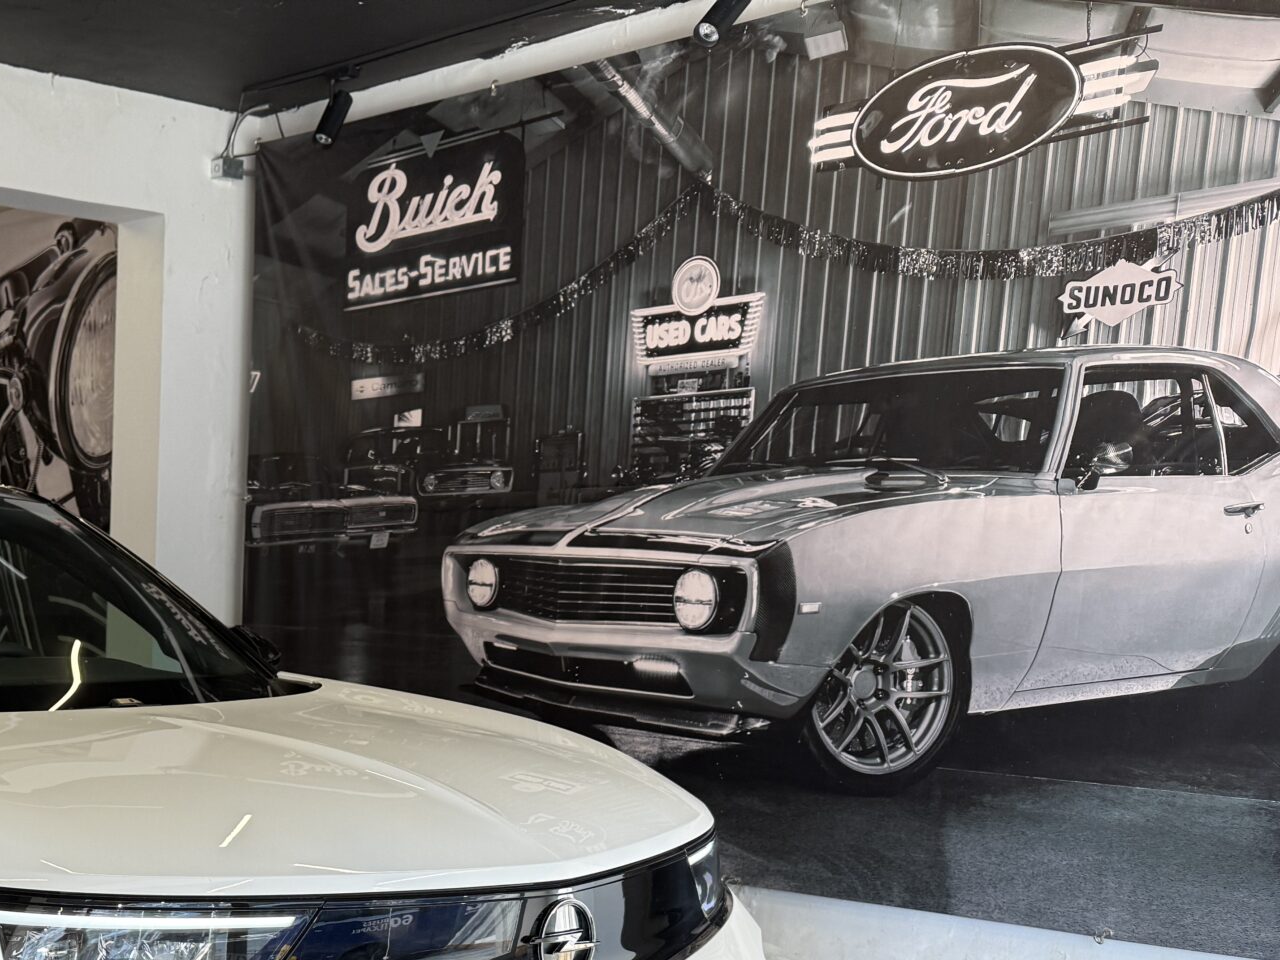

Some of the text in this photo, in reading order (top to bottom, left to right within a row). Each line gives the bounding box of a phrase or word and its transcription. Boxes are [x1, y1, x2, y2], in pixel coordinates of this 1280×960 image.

[880, 62, 1038, 154] Ford
[355, 161, 502, 253] Buick
[347, 246, 512, 300] SALES-SERVICE
[1067, 276, 1173, 311] SUNOCO
[646, 313, 742, 349] USED CARS
[658, 357, 726, 373] AUTHORIZED DEALER
